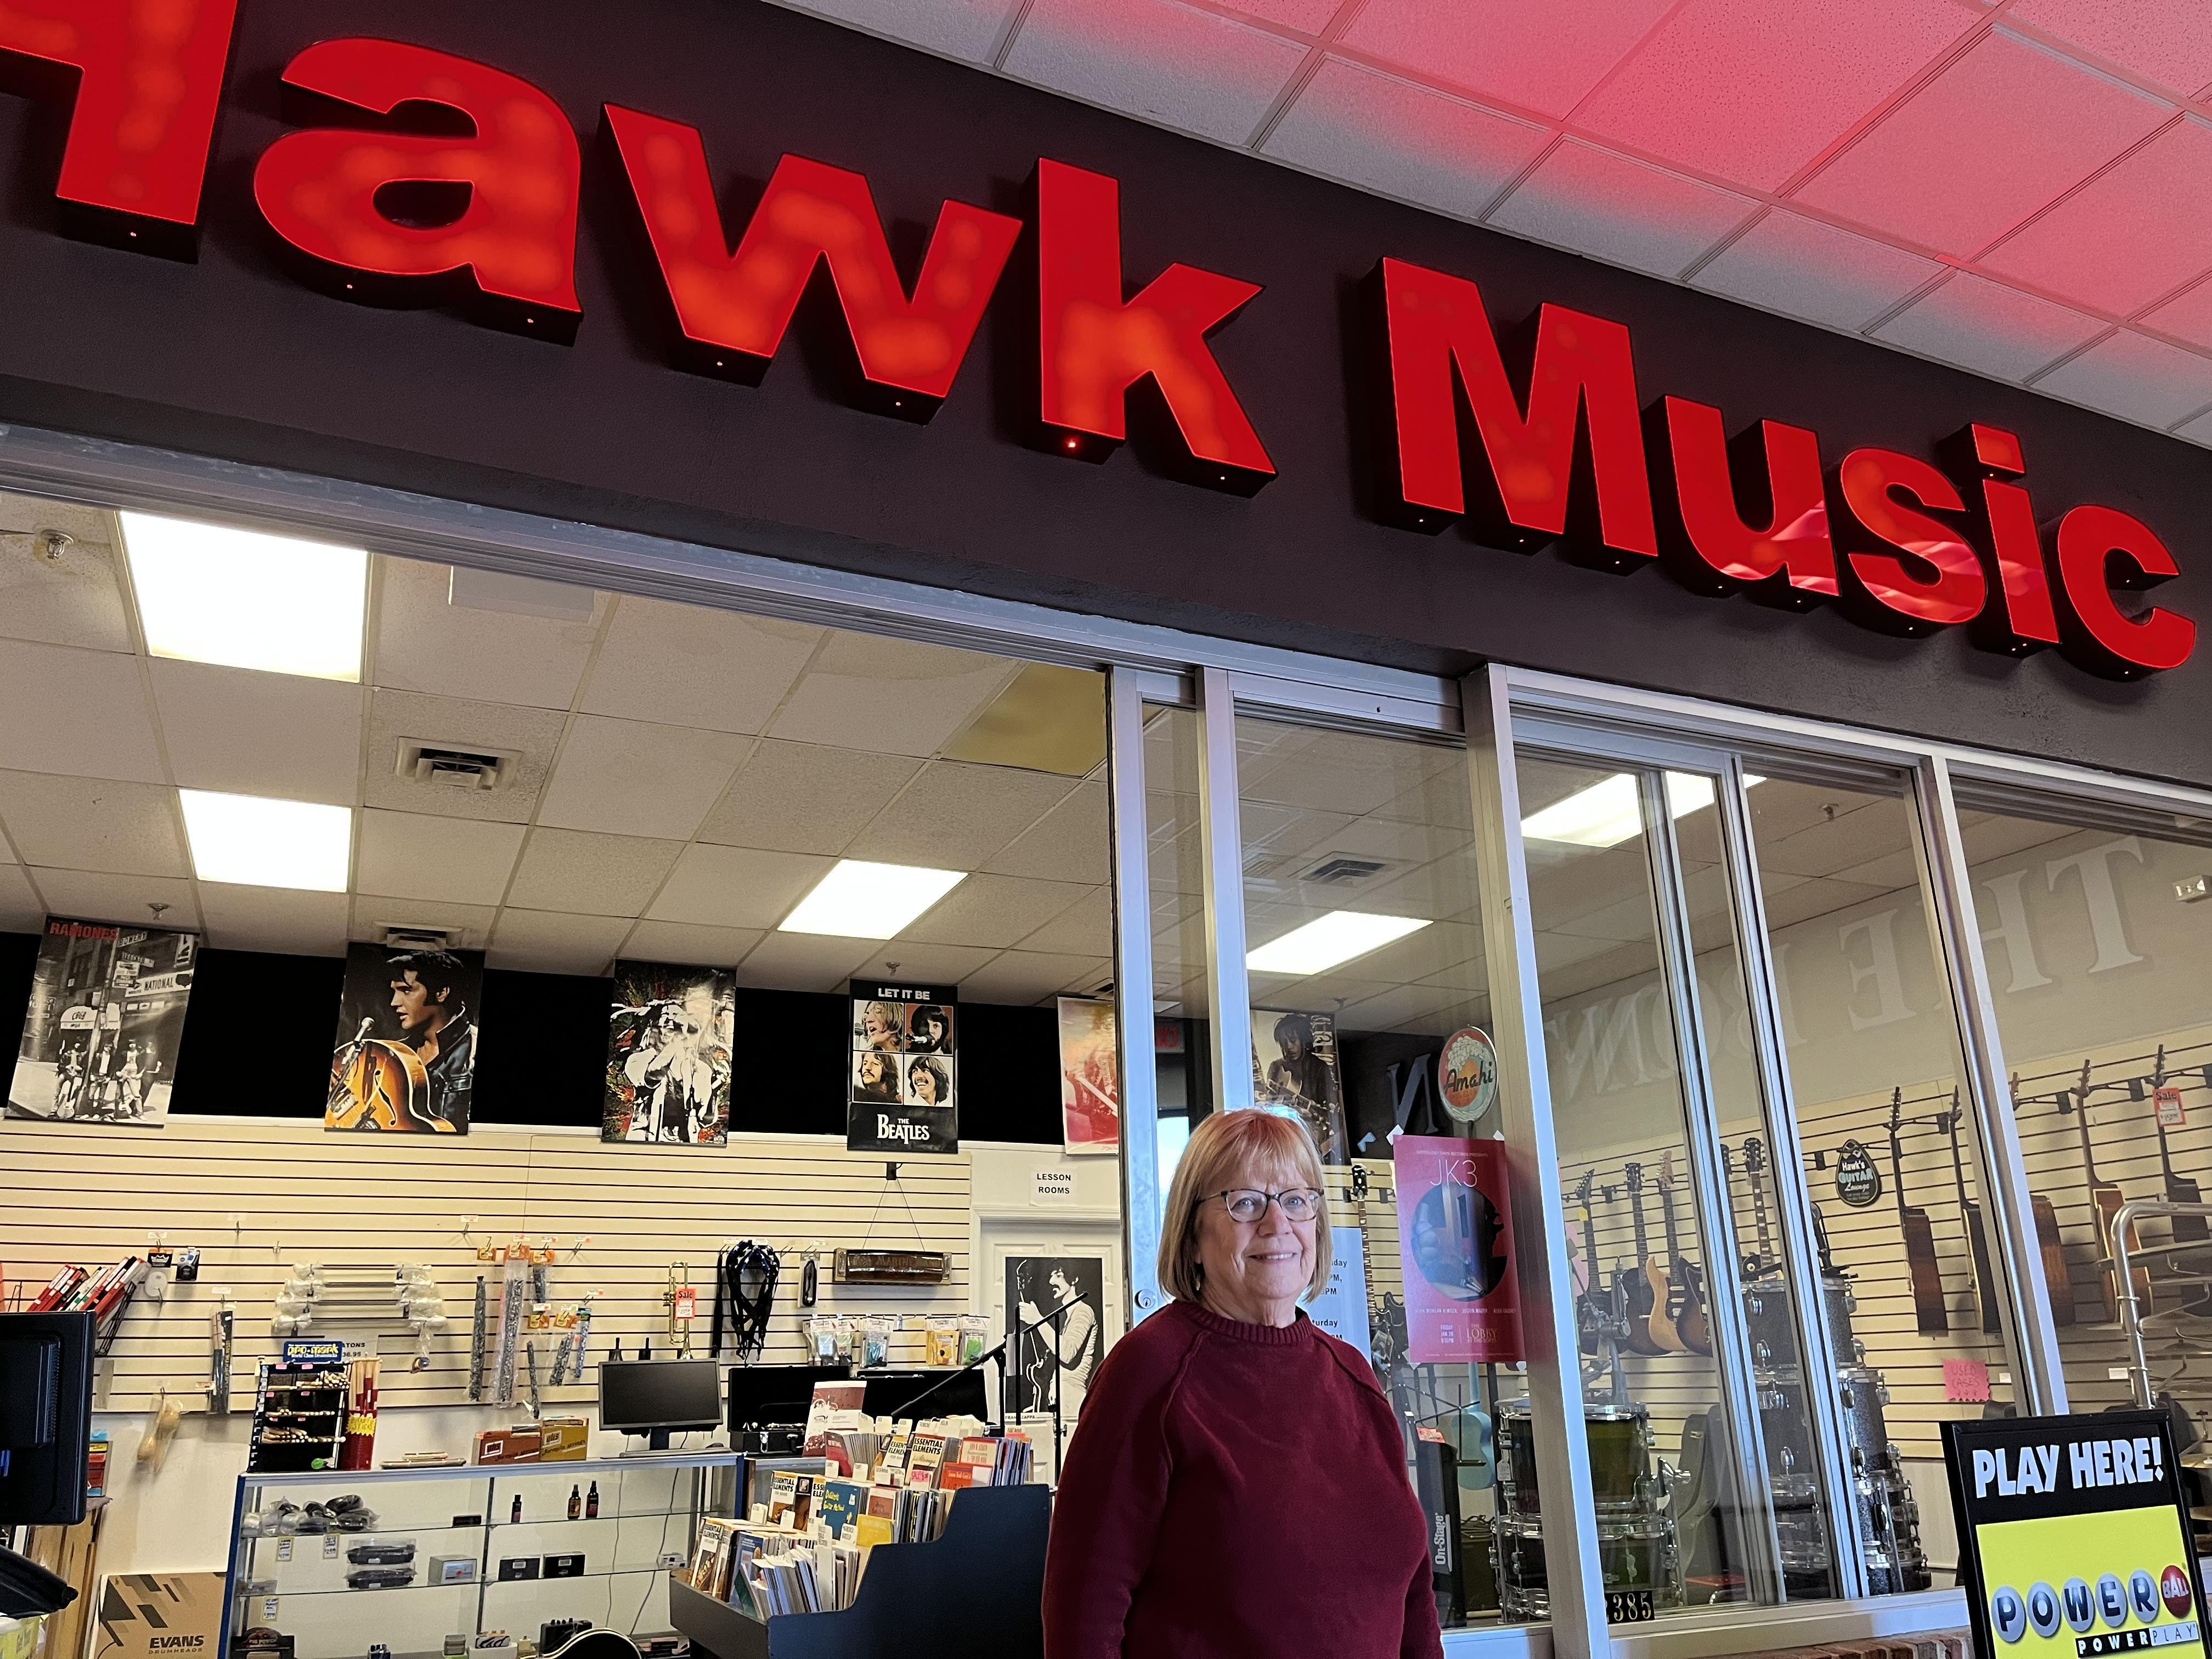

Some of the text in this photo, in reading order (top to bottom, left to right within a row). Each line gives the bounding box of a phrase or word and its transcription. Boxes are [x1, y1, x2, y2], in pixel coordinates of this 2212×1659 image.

[1383, 256, 2196, 669] Music
[50, 922, 119, 941] RAMONES
[144, 976, 174, 991] NATIONAL
[878, 988, 930, 1000] LET IT BE
[1443, 1060, 1494, 1096] Amahi
[2155, 1091, 2177, 1101] Sale
[877, 1114, 930, 1144] BEATLES
[1842, 1160, 1865, 1171] Hawk's
[1036, 1173, 1071, 1181] LESSON
[1430, 1159, 1477, 1187] JK3
[1838, 1168, 1874, 1184] GUITAR
[678, 1290, 693, 1299] Sale
[1321, 1287, 1337, 1295] PM
[1312, 1319, 1338, 1328] turday
[1467, 1328, 1497, 1339] LOBBY
[1951, 1364, 1976, 1376] USED
[1952, 1377, 1980, 1389] CASES
[890, 1441, 906, 1449] ESSENT
[915, 1437, 943, 1448] ESSENTIAL
[912, 1444, 941, 1455] ELEMENTS
[1973, 1437, 2164, 1498] PLAY HERE!
[773, 1476, 794, 1486] ESSENTIAL
[772, 1483, 794, 1492] ELEMENTS
[1434, 1515, 1446, 1565] On-Stage
[1605, 1592, 1651, 1623] 385
[1996, 1577, 2190, 1632] POWER BALL
[149, 1635, 205, 1649] EVANS
